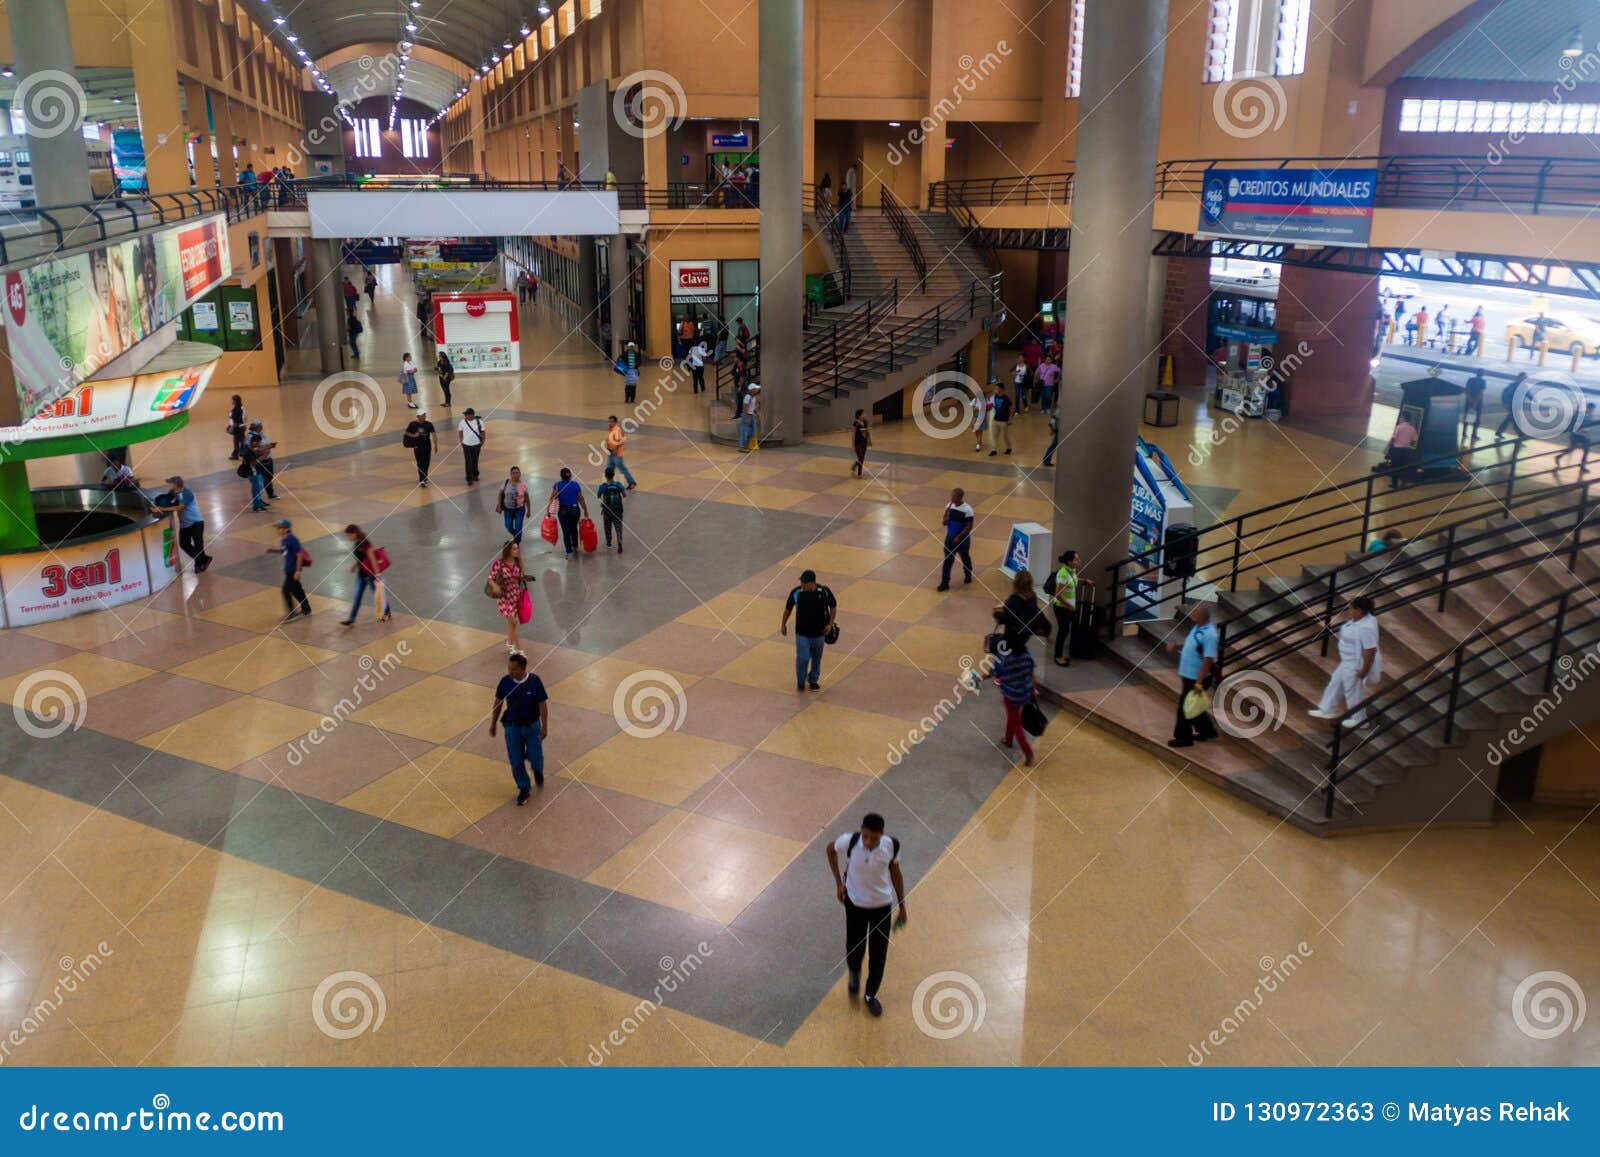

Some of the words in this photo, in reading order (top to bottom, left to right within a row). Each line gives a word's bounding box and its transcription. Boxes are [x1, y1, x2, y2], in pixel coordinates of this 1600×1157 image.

[1239, 180, 1289, 197] CREDITOS
[1291, 181, 1371, 199] MUNDIALES
[680, 273, 709, 285] Clave
[36, 386, 94, 420] en1
[41, 548, 122, 599] 3en1
[19, 601, 60, 614] Terminal
[121, 580, 143, 593] Metro
